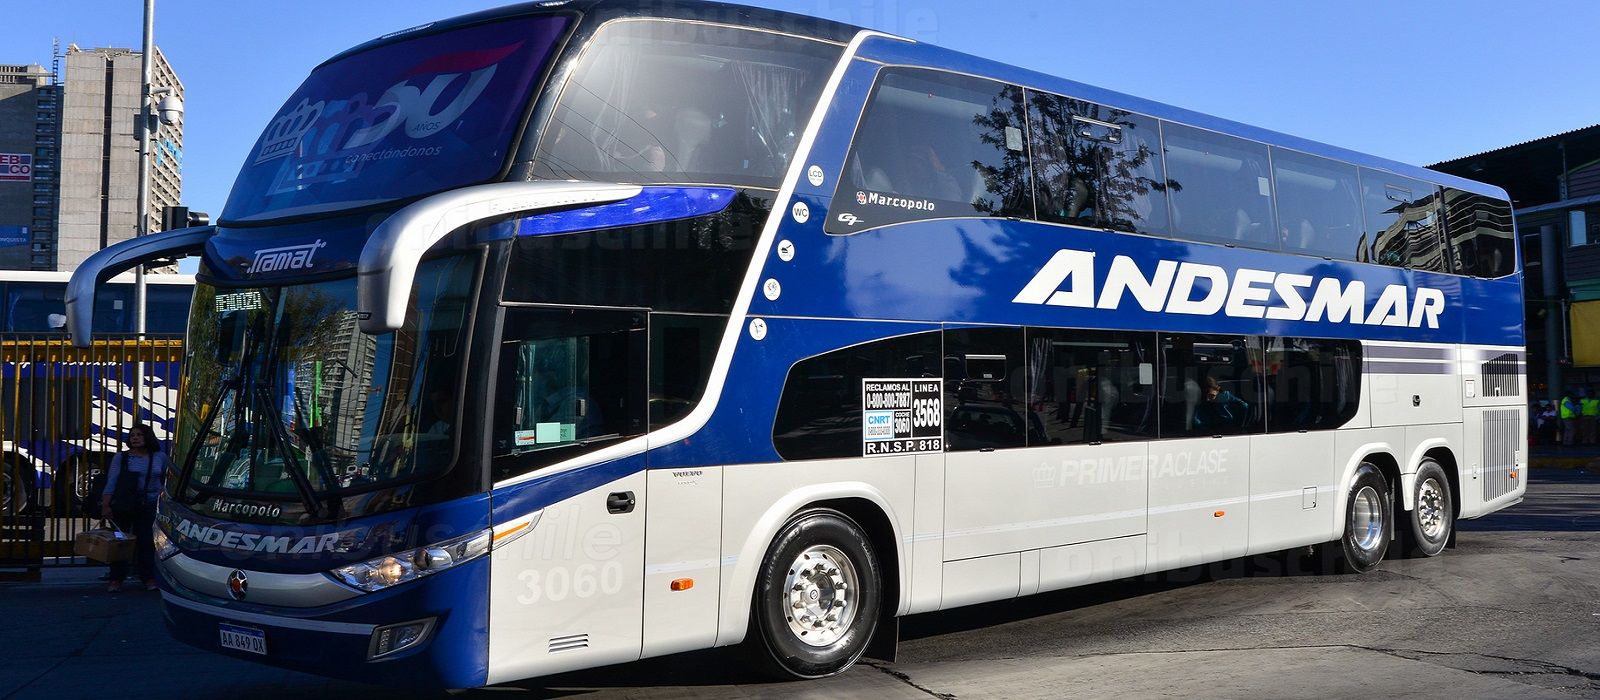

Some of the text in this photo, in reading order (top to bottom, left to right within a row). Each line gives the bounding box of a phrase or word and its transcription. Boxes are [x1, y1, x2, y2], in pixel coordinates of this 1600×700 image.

[413, 120, 442, 132] AÑOS
[344, 144, 443, 163] conectándonos
[809, 170, 823, 178] LCD
[868, 192, 935, 211] Marcopolo
[794, 208, 809, 217] WC
[246, 239, 326, 273] Tramat
[1012, 249, 1445, 328] ANDESMAR
[214, 291, 262, 313] MENDOZA
[866, 383, 910, 392] RECLAMOS AL
[914, 384, 939, 393] LINEA
[868, 415, 890, 425] CNRT
[913, 398, 940, 428] 3568
[894, 418, 910, 434] 3060
[867, 440, 940, 454] R.N.S.P. 818
[212, 498, 281, 518] Marcopolo
[175, 518, 340, 554] ANDESMAR
[516, 561, 624, 606] 3060
[223, 632, 234, 646] AA
[235, 634, 251, 649] 849
